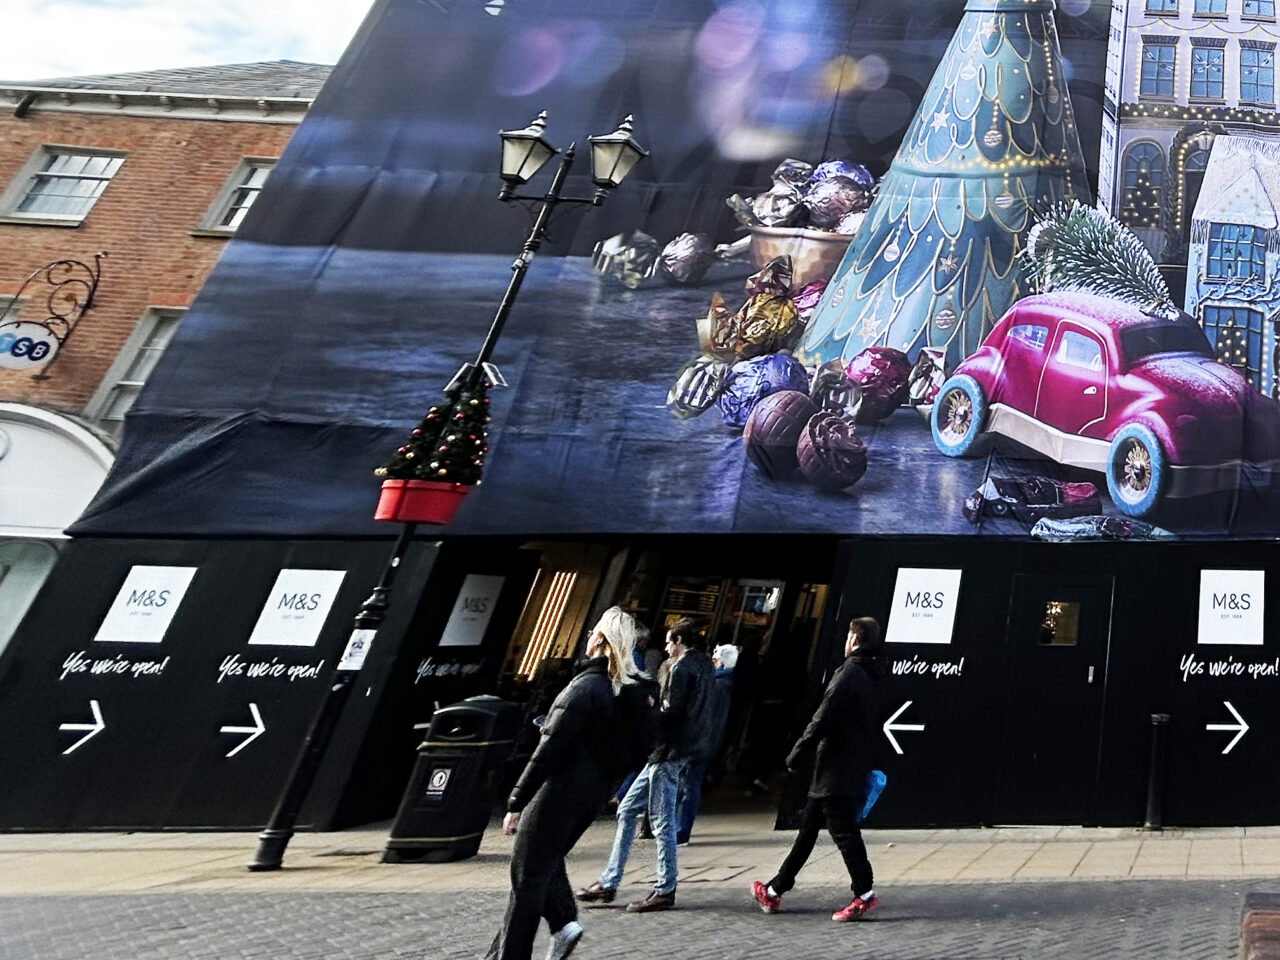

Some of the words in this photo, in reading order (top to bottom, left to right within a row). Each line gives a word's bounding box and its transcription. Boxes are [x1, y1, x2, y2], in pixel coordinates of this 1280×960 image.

[127, 589, 171, 607] M&S
[278, 593, 321, 611] M&S
[904, 591, 945, 609] M&S
[1212, 592, 1251, 610] M&S
[59, 651, 90, 680] Yes
[91, 654, 131, 675] we're
[131, 656, 170, 677] open!
[216, 654, 246, 683] Yes
[247, 657, 286, 677] we're
[287, 660, 324, 681] open!
[892, 654, 929, 675] we're
[931, 657, 965, 679] open!
[1180, 653, 1205, 682] Yes
[1209, 656, 1245, 676] we're
[1248, 657, 1279, 679] open!
